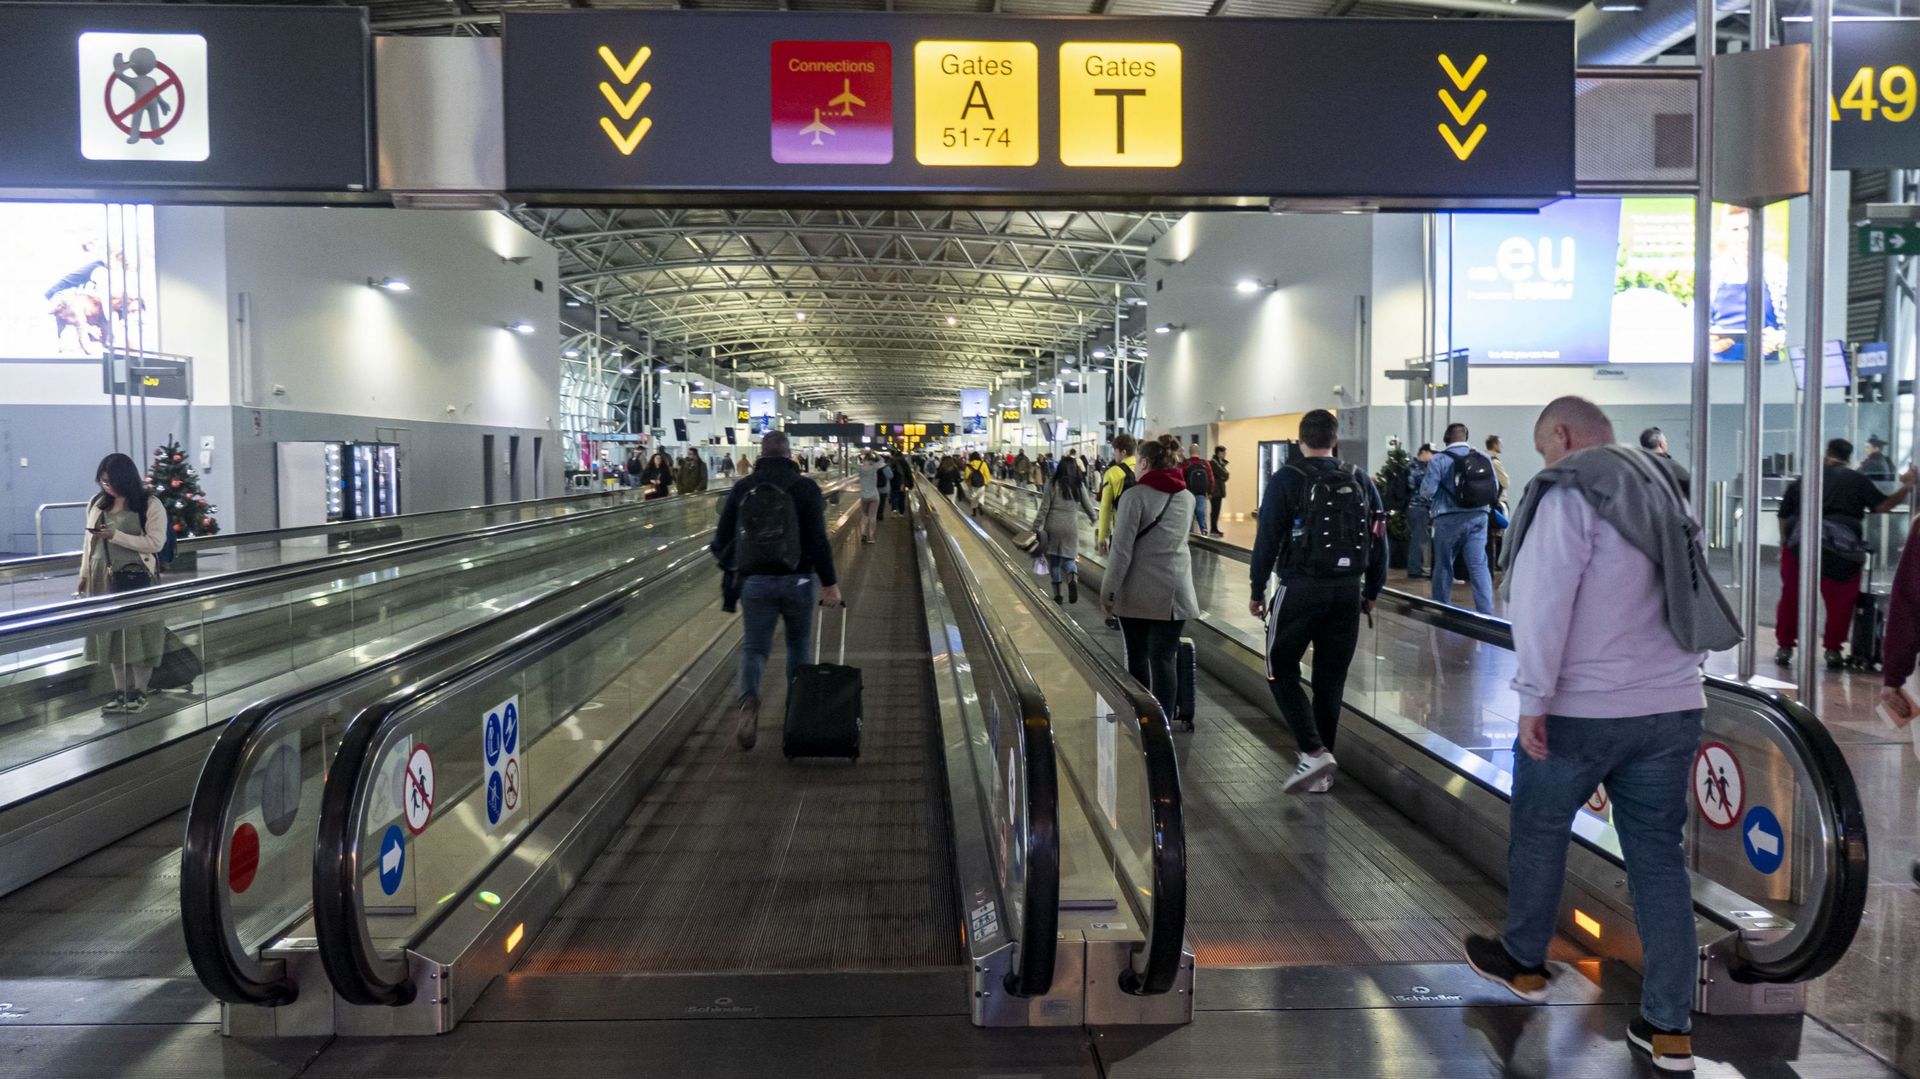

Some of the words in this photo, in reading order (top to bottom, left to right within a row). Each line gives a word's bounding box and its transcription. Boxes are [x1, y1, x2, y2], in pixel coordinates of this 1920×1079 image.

[788, 58, 875, 72] Connections
[940, 53, 1013, 76] Gates
[1085, 55, 1156, 77] Gates
[960, 80, 994, 120] A
[1094, 88, 1146, 154] T
[942, 127, 1012, 148] 51-74
[690, 398, 711, 409] A52
[1033, 398, 1052, 409] A51
